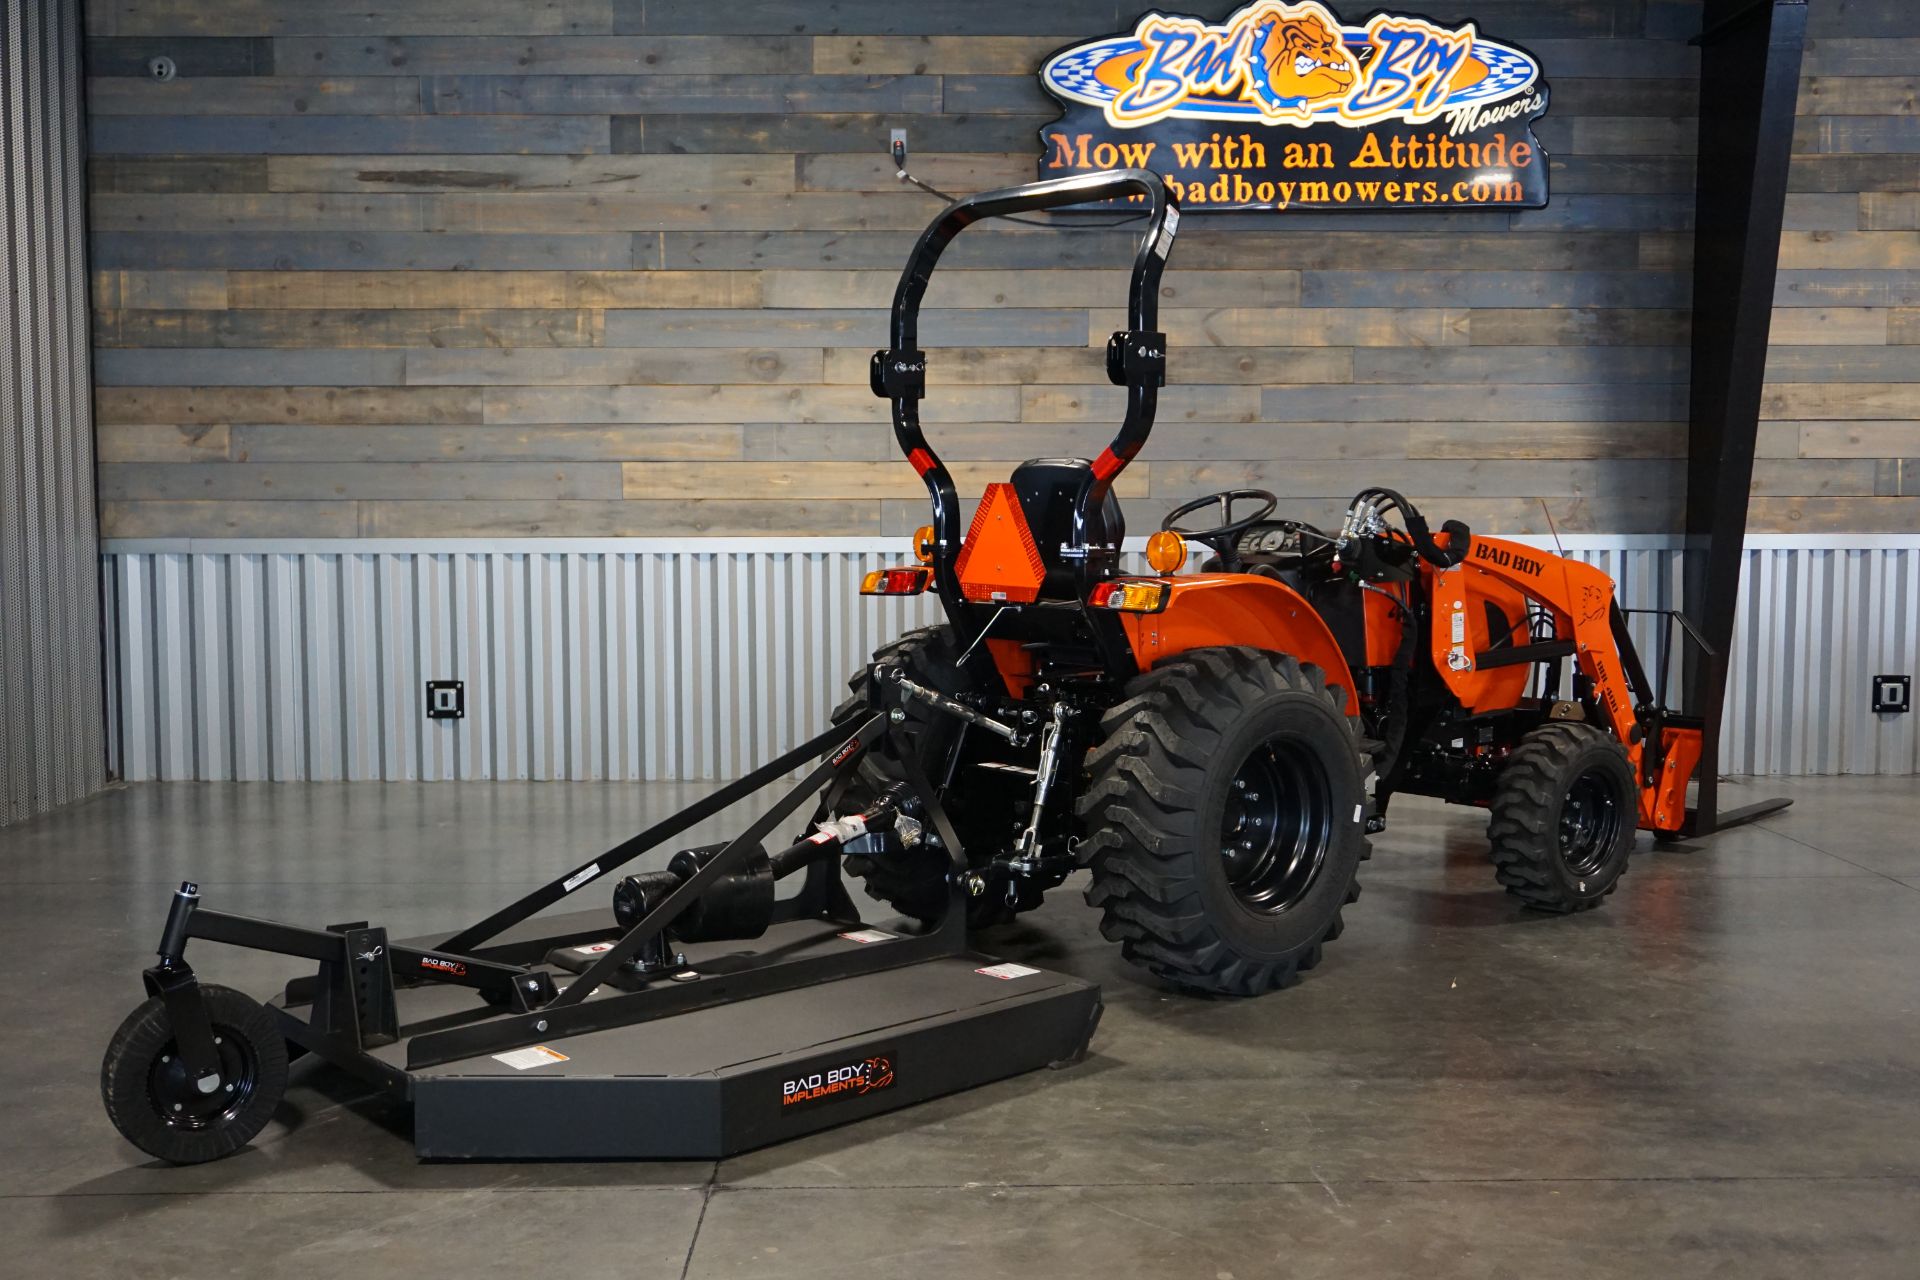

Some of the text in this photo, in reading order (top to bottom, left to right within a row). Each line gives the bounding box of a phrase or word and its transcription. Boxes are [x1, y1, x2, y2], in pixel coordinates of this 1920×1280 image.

[1118, 24, 1468, 113] Bad Boy
[1445, 93, 1545, 137] Mowers
[1048, 132, 1532, 169] Mow with an Attitude
[1475, 542, 1546, 577] BAD BOY
[422, 957, 438, 965] BAD
[783, 1076, 865, 1105] IMPLEMENTS
[784, 1063, 865, 1095] BAD BOY
